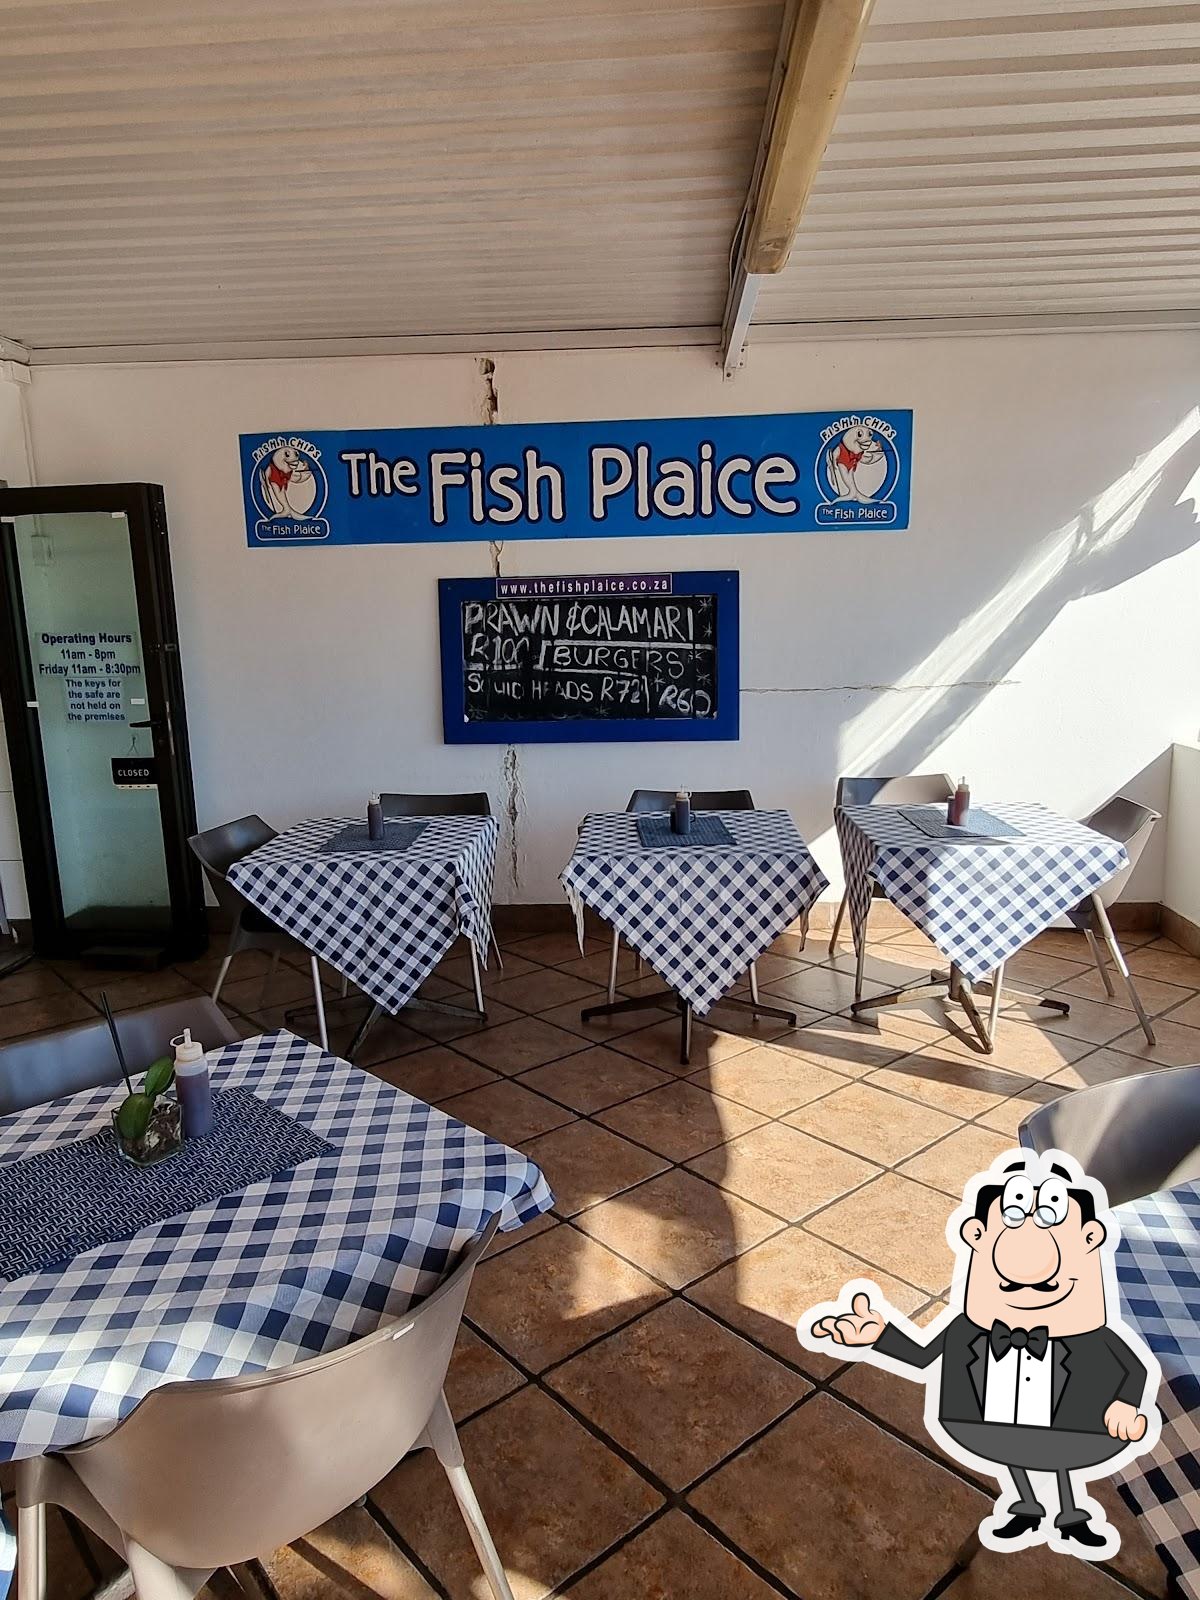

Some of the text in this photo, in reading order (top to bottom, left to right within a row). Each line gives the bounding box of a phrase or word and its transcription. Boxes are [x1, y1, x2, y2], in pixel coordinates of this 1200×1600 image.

[821, 419, 849, 441] FISH
[863, 416, 896, 439] CHIPS
[252, 439, 277, 461] FISH
[289, 437, 321, 459] CHIPS
[340, 441, 799, 524] The Fish Plaice
[822, 507, 888, 519] The Fish Plaice
[272, 524, 291, 535] Fish
[293, 523, 321, 535] Plaice
[500, 579, 668, 595] www.thefishplaice.co.za
[465, 602, 560, 637] PRAWN
[41, 632, 132, 646] Operating Hours
[60, 648, 86, 659] 11am
[94, 648, 116, 661] 8pm
[553, 646, 685, 679] BURGERS
[38, 663, 69, 676] Friday
[72, 663, 97, 674] 11am
[105, 663, 141, 675] 8:30pm
[65, 678, 121, 689] The keys for
[68, 690, 83, 698] the
[84, 690, 104, 698] safe
[70, 701, 86, 709] not
[87, 701, 107, 709] held
[67, 712, 126, 722] the premises
[117, 768, 150, 777] CLOSED
